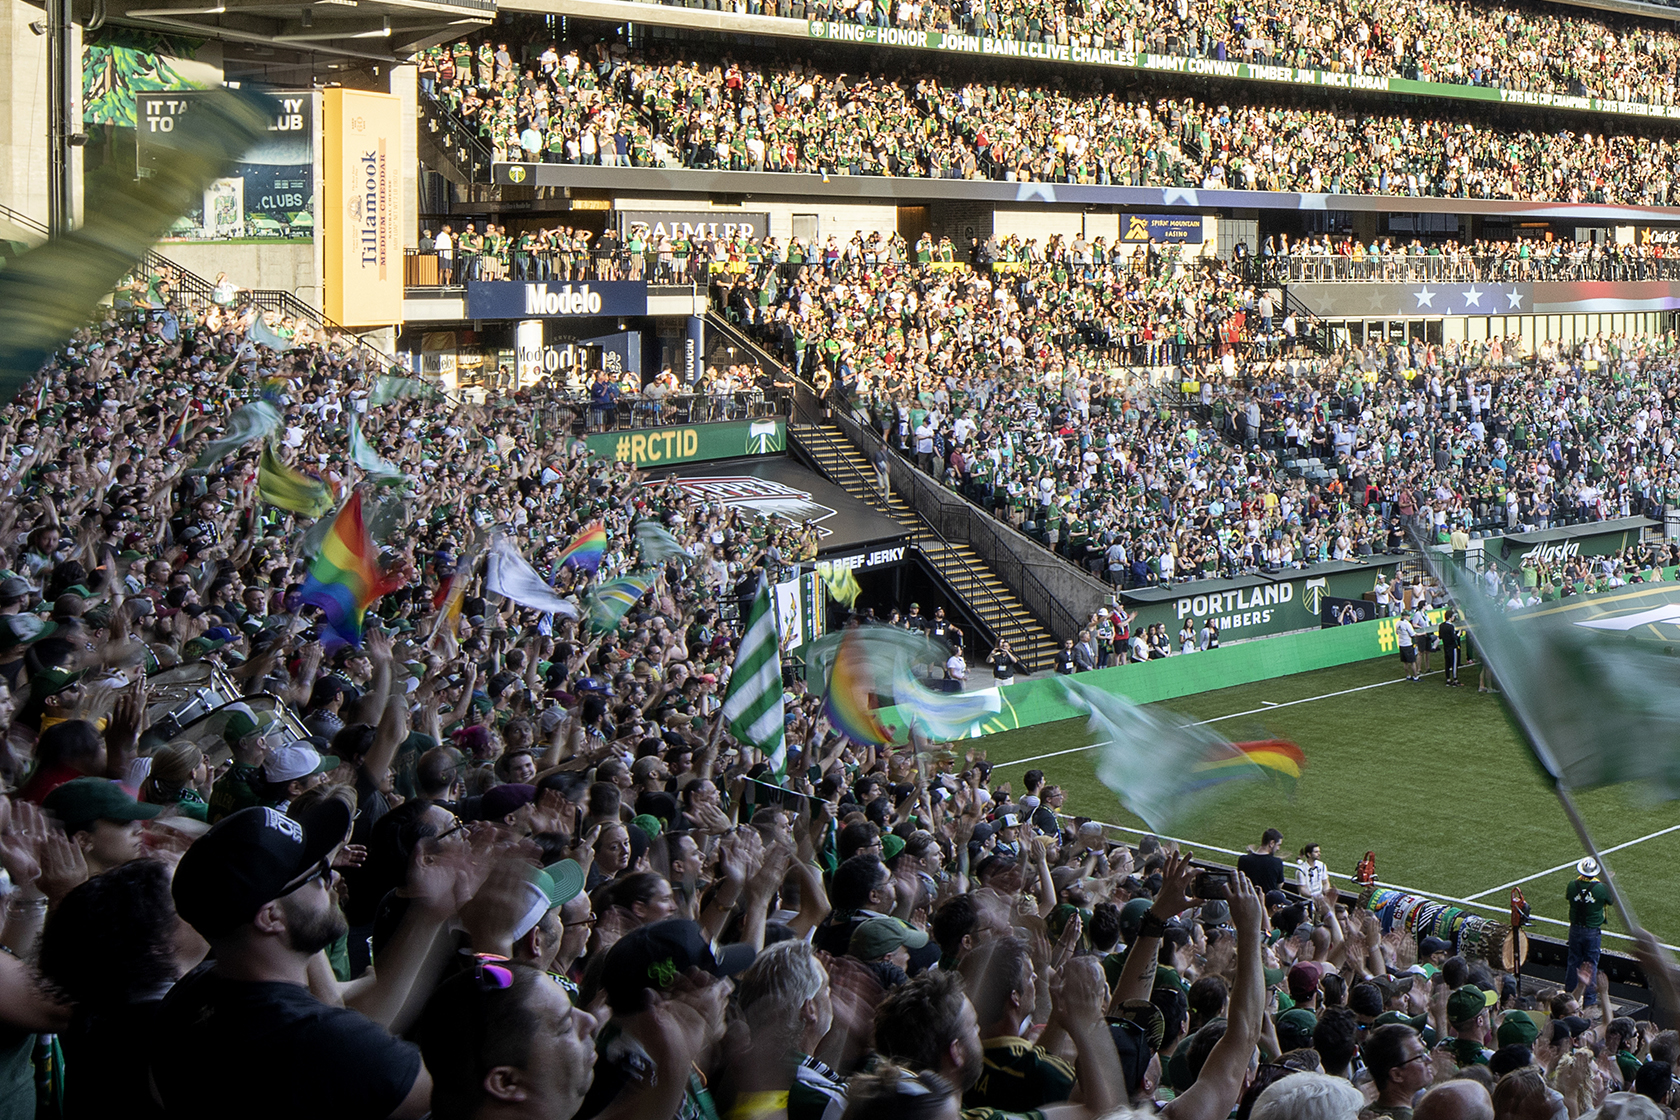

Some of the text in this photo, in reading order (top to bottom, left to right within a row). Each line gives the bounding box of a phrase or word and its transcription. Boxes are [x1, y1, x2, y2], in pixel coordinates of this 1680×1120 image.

[829, 22, 928, 48] RING OF HONOR
[937, 34, 1019, 56] JOHN BAIN
[1028, 42, 1136, 67] CLIVE CHARLES
[1144, 53, 1240, 77] JIMMY CONWAY
[1247, 63, 1316, 84] TIMBER JIM
[1321, 71, 1390, 91] MICK HOBAN
[146, 100, 164, 115] IT
[1524, 92, 1539, 104] MLS
[1539, 94, 1552, 106] CUP
[1552, 94, 1591, 110] CHAMPIONS
[1618, 101, 1648, 115] WESTERN
[147, 117, 174, 132] TO
[261, 193, 303, 209] CLUBS
[361, 149, 377, 269] Tillamook
[525, 283, 601, 314] Modelo
[425, 355, 452, 371] Modelo
[615, 429, 698, 462] #RCTID
[833, 554, 865, 571] BEEF
[866, 546, 905, 567] JERKY
[1521, 541, 1580, 563] Alaska
[1177, 582, 1294, 620] PORTLAND
